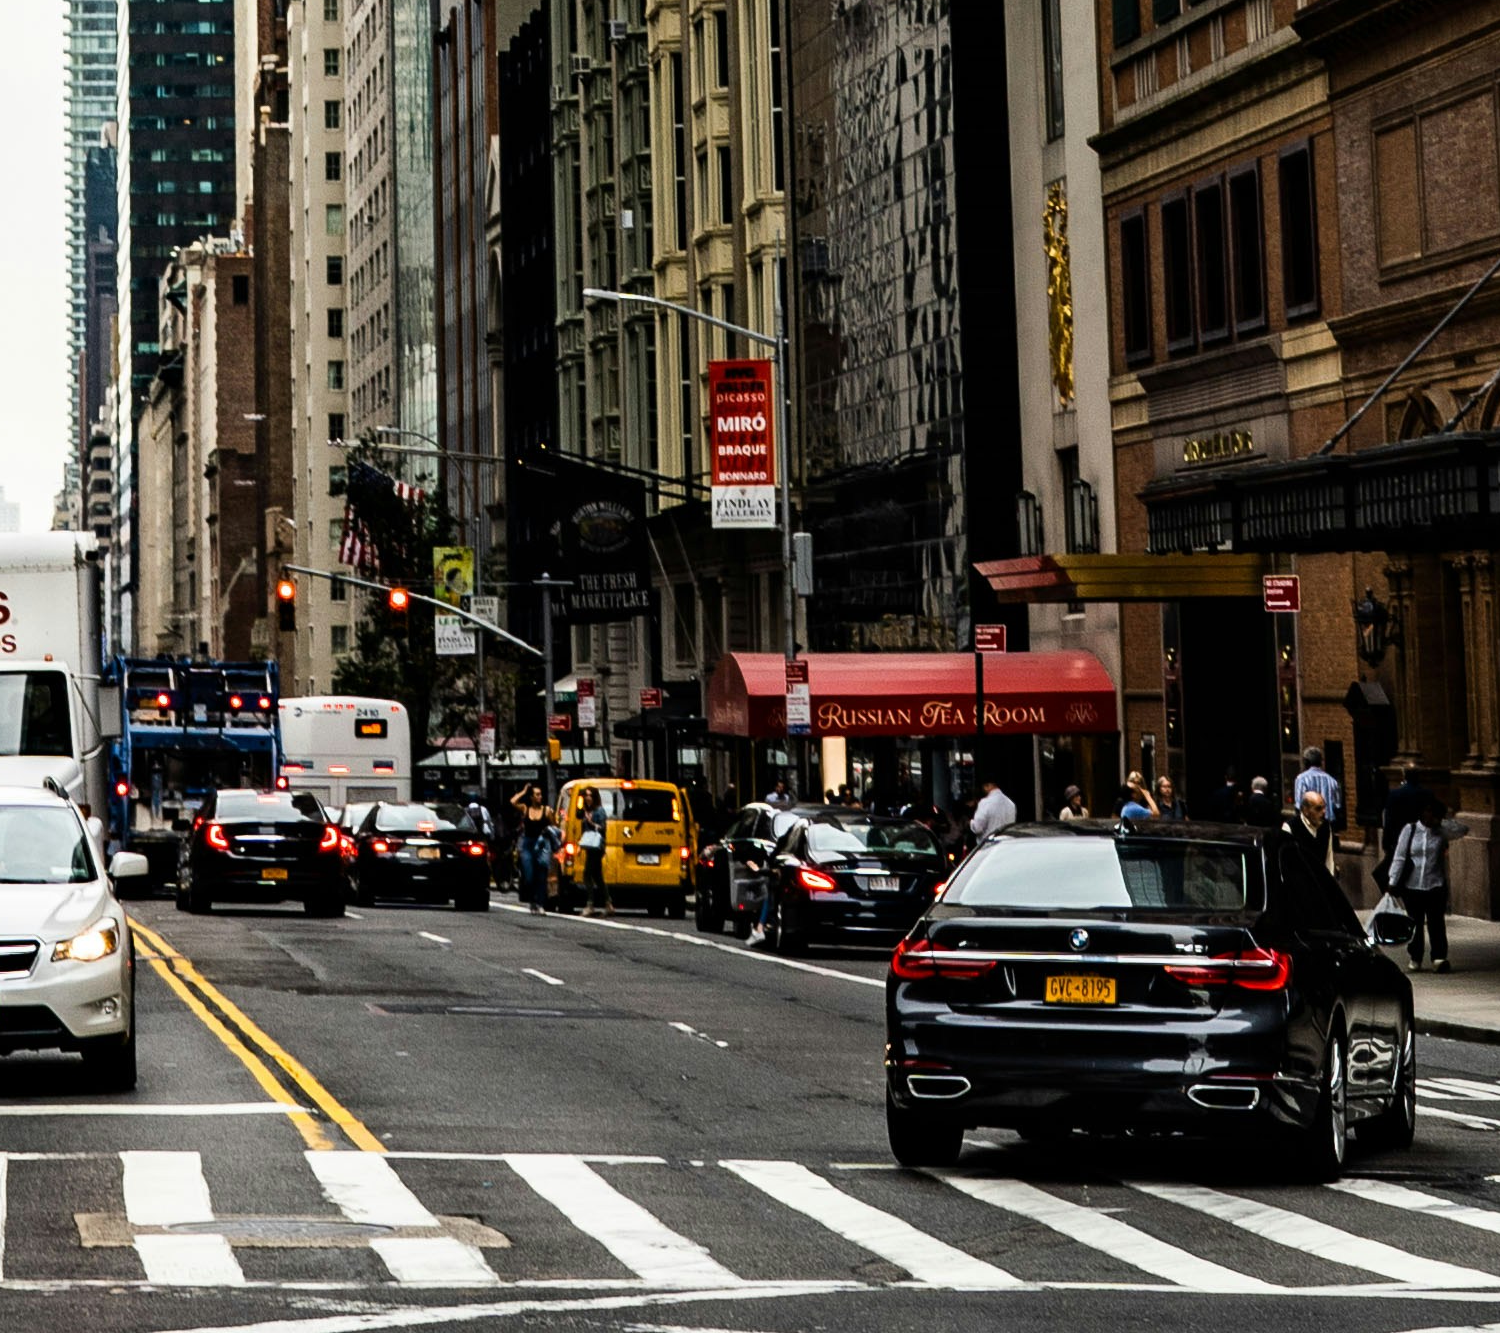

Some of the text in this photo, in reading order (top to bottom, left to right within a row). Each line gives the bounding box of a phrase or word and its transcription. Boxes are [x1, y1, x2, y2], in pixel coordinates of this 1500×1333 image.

[716, 392, 766, 406] picasso
[717, 411, 767, 433] MIRÓ
[718, 444, 768, 457] BRAQUE
[718, 471, 768, 481] BONNARD
[716, 498, 771, 509] FINDLAY
[579, 573, 637, 590] THE FRESH
[571, 589, 650, 609] MARKETPLACE
[817, 701, 912, 729] RUSSIAN
[919, 700, 965, 728] TEA
[973, 699, 1047, 727] ROOM
